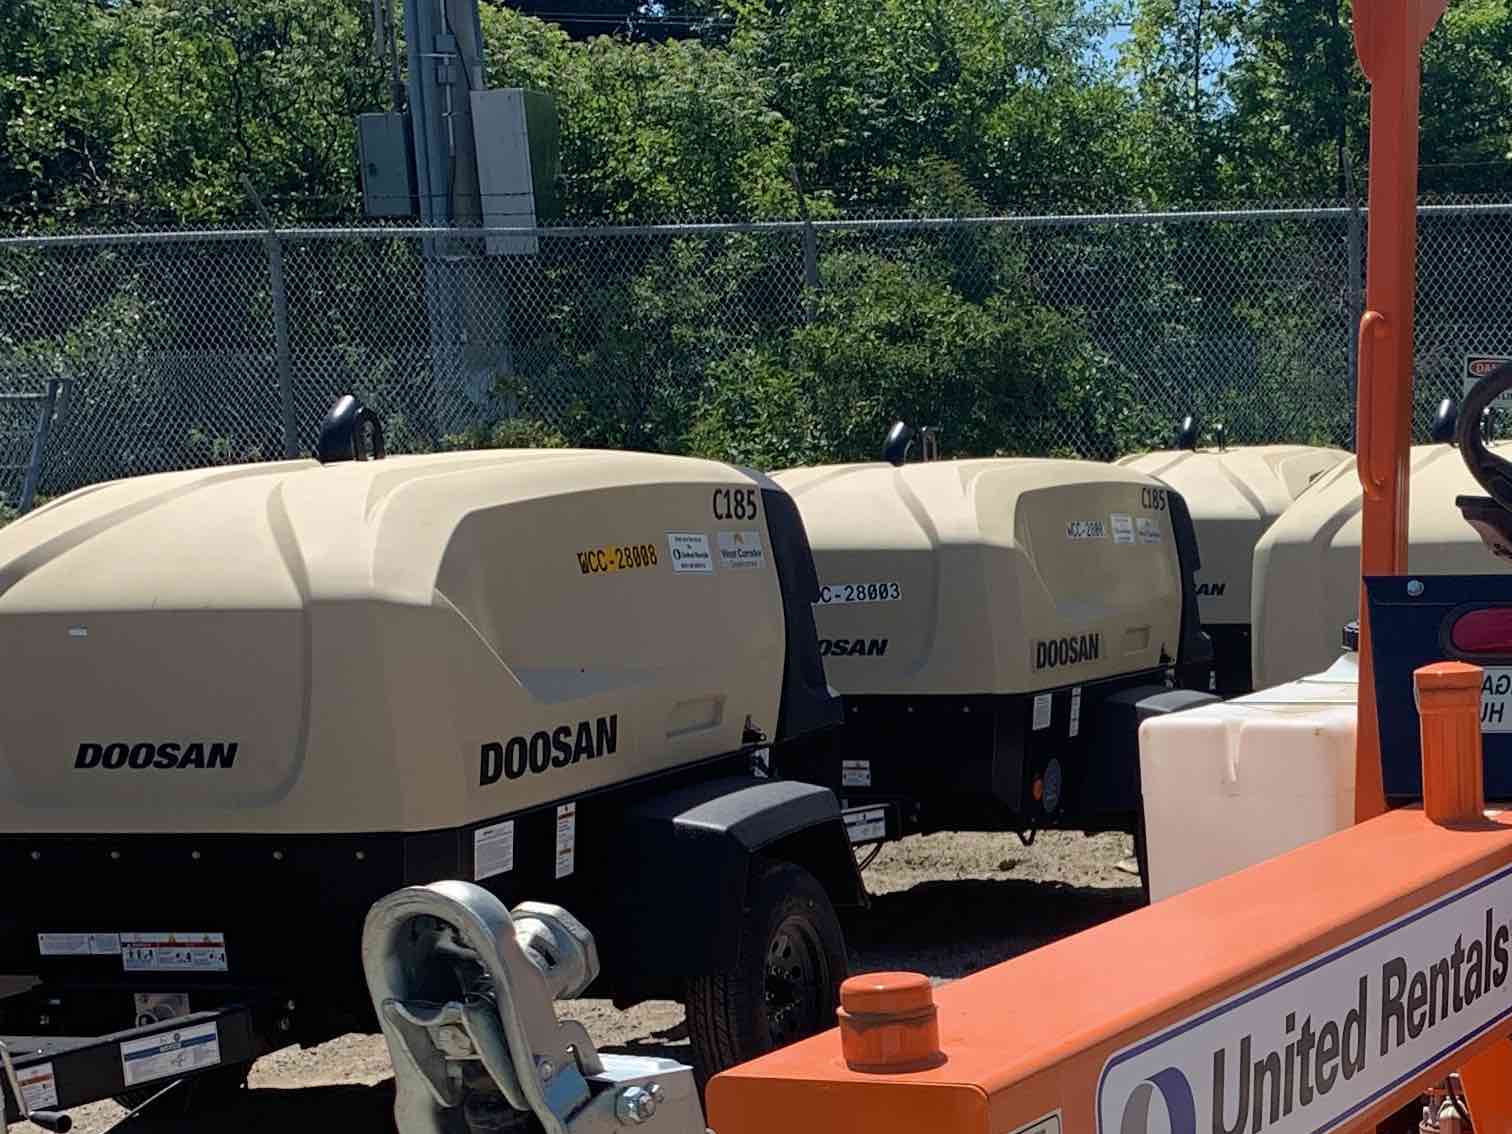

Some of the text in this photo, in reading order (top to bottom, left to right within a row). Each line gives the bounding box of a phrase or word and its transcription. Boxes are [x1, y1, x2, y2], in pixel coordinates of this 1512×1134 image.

[713, 488, 757, 520] C185
[1141, 488, 1166, 511] C185
[1036, 633, 1100, 669] DOOSAN
[74, 743, 238, 770] DOOSAN
[479, 714, 619, 785] DOOSAN
[1379, 908, 1510, 1056] Rentals
